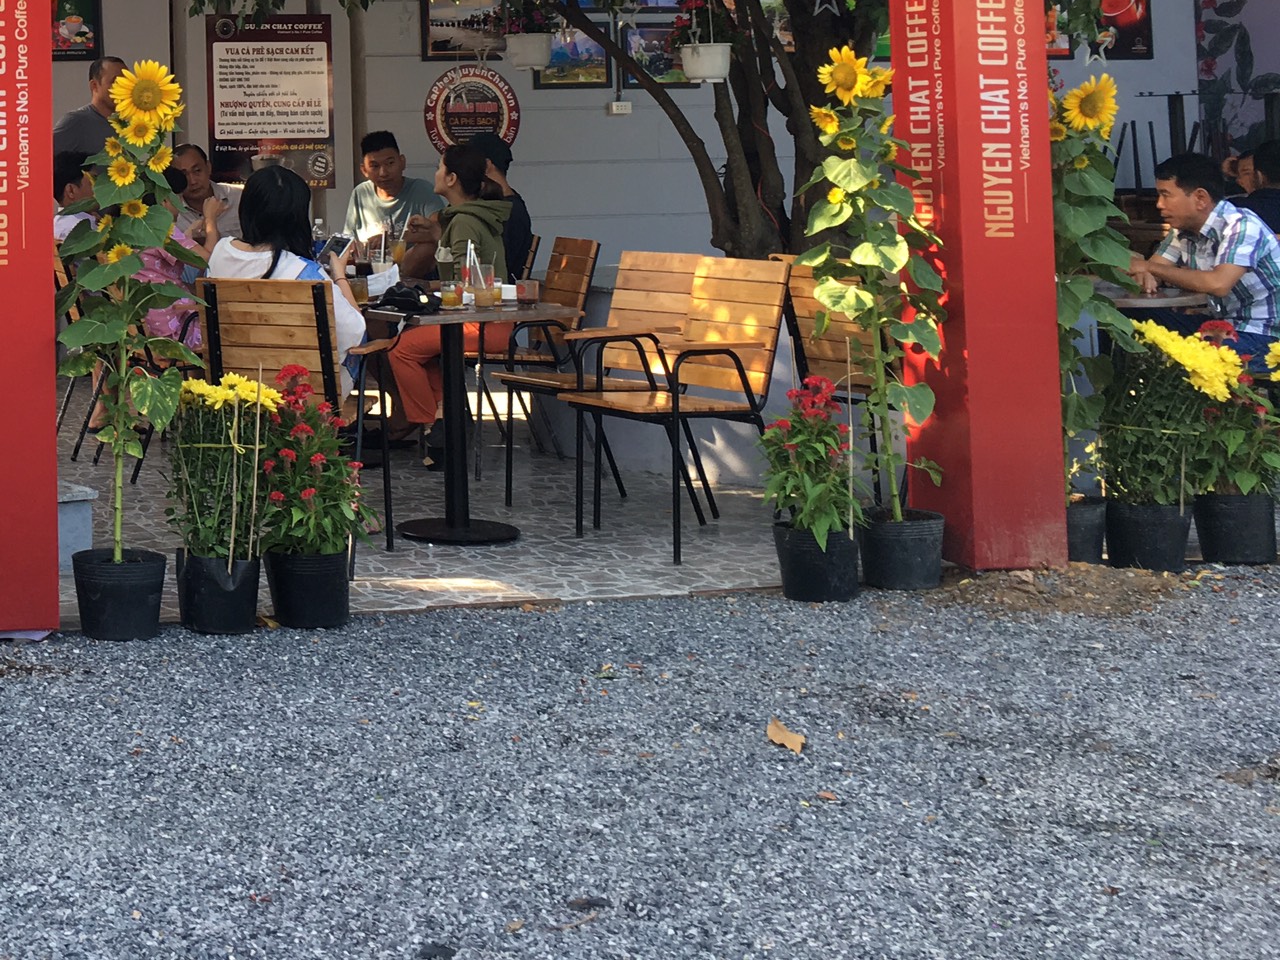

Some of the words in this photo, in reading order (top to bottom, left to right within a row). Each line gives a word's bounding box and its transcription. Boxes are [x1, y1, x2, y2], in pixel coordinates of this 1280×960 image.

[16, 44, 30, 80] Pure
[933, 38, 942, 71] Pure
[1015, 37, 1028, 71] Pure
[909, 76, 933, 135] CHAT
[979, 74, 1012, 136] CHAT
[17, 113, 30, 191] Vietnam's
[1018, 101, 1031, 170] Vietnam's
[981, 142, 1015, 239] NGUYEN
